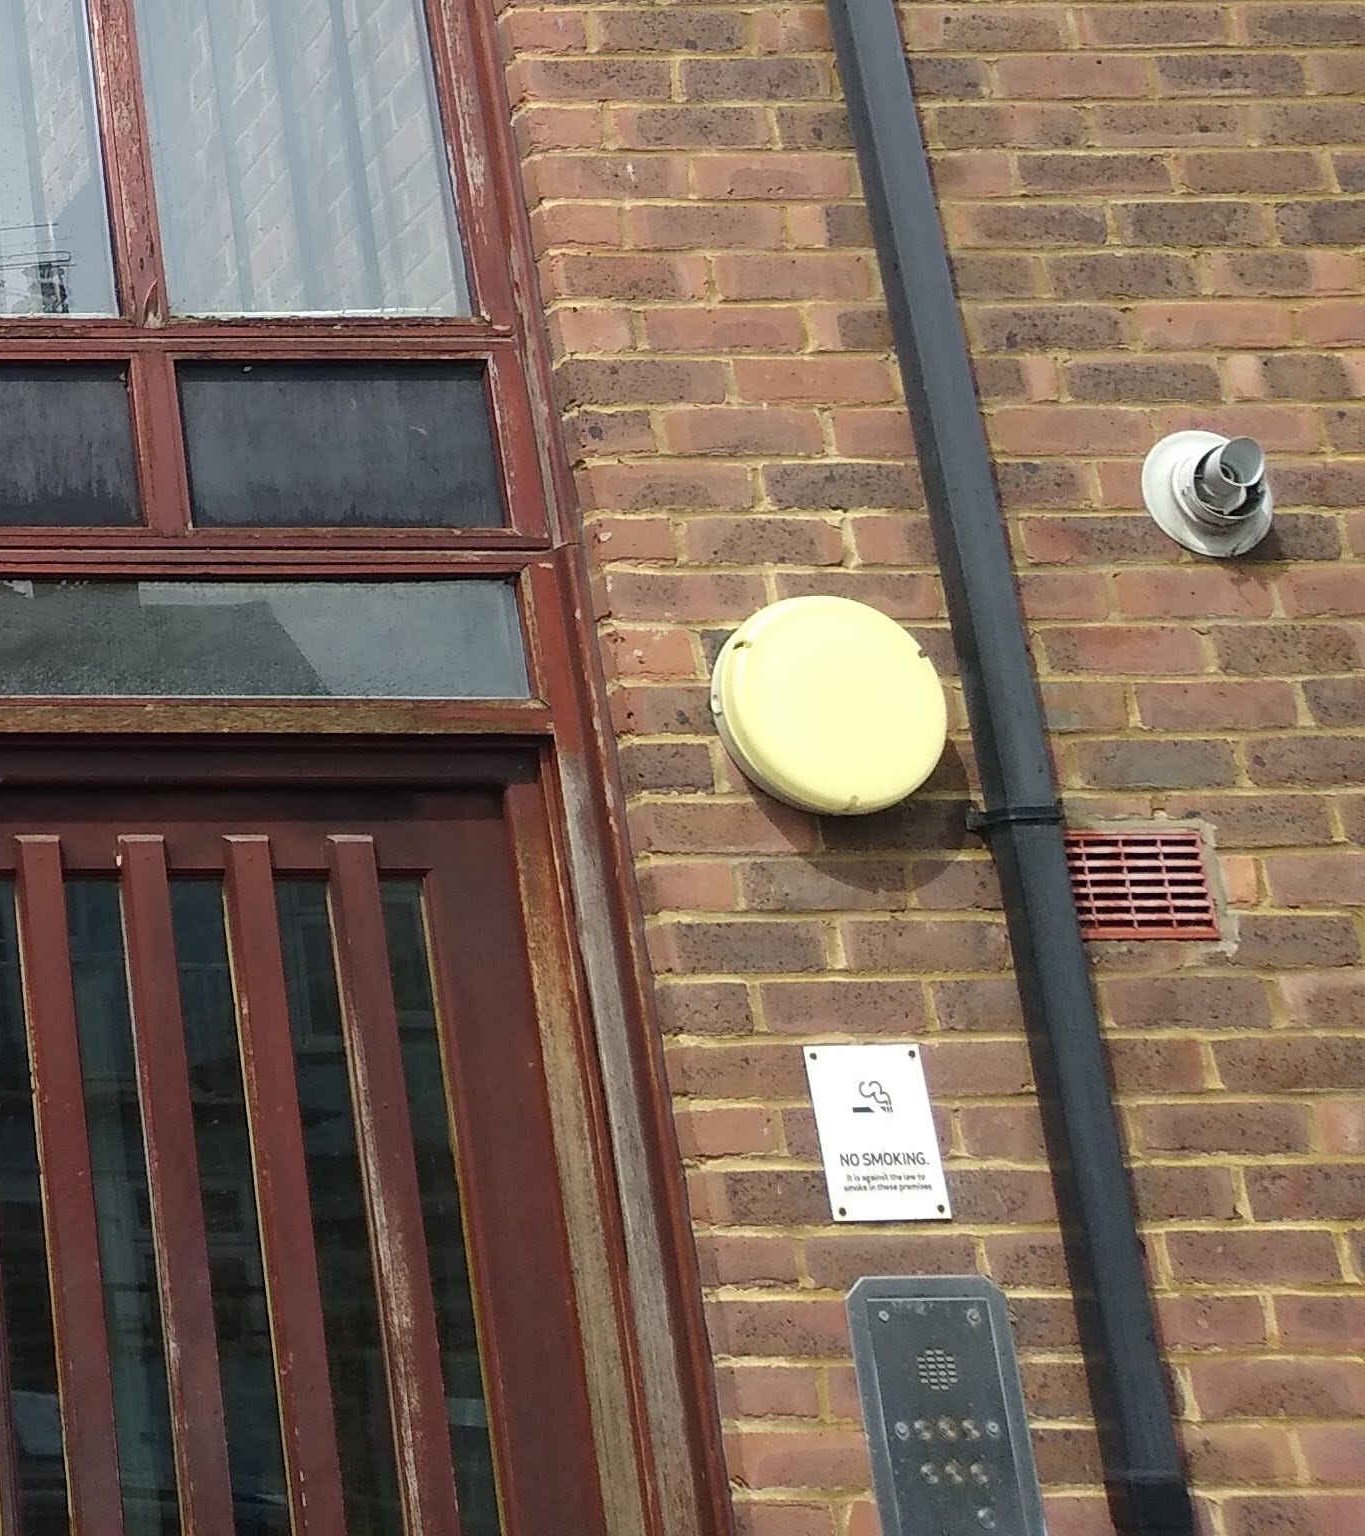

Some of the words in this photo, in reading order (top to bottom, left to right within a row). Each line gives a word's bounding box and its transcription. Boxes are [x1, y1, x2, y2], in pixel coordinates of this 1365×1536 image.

[839, 1153, 860, 1167] NO
[862, 1152, 930, 1166] SMOKING.
[862, 1172, 889, 1184] against
[890, 1173, 902, 1181] the
[844, 1184, 867, 1192] smoke
[877, 1183, 898, 1191] these
[899, 1183, 933, 1192] premises
